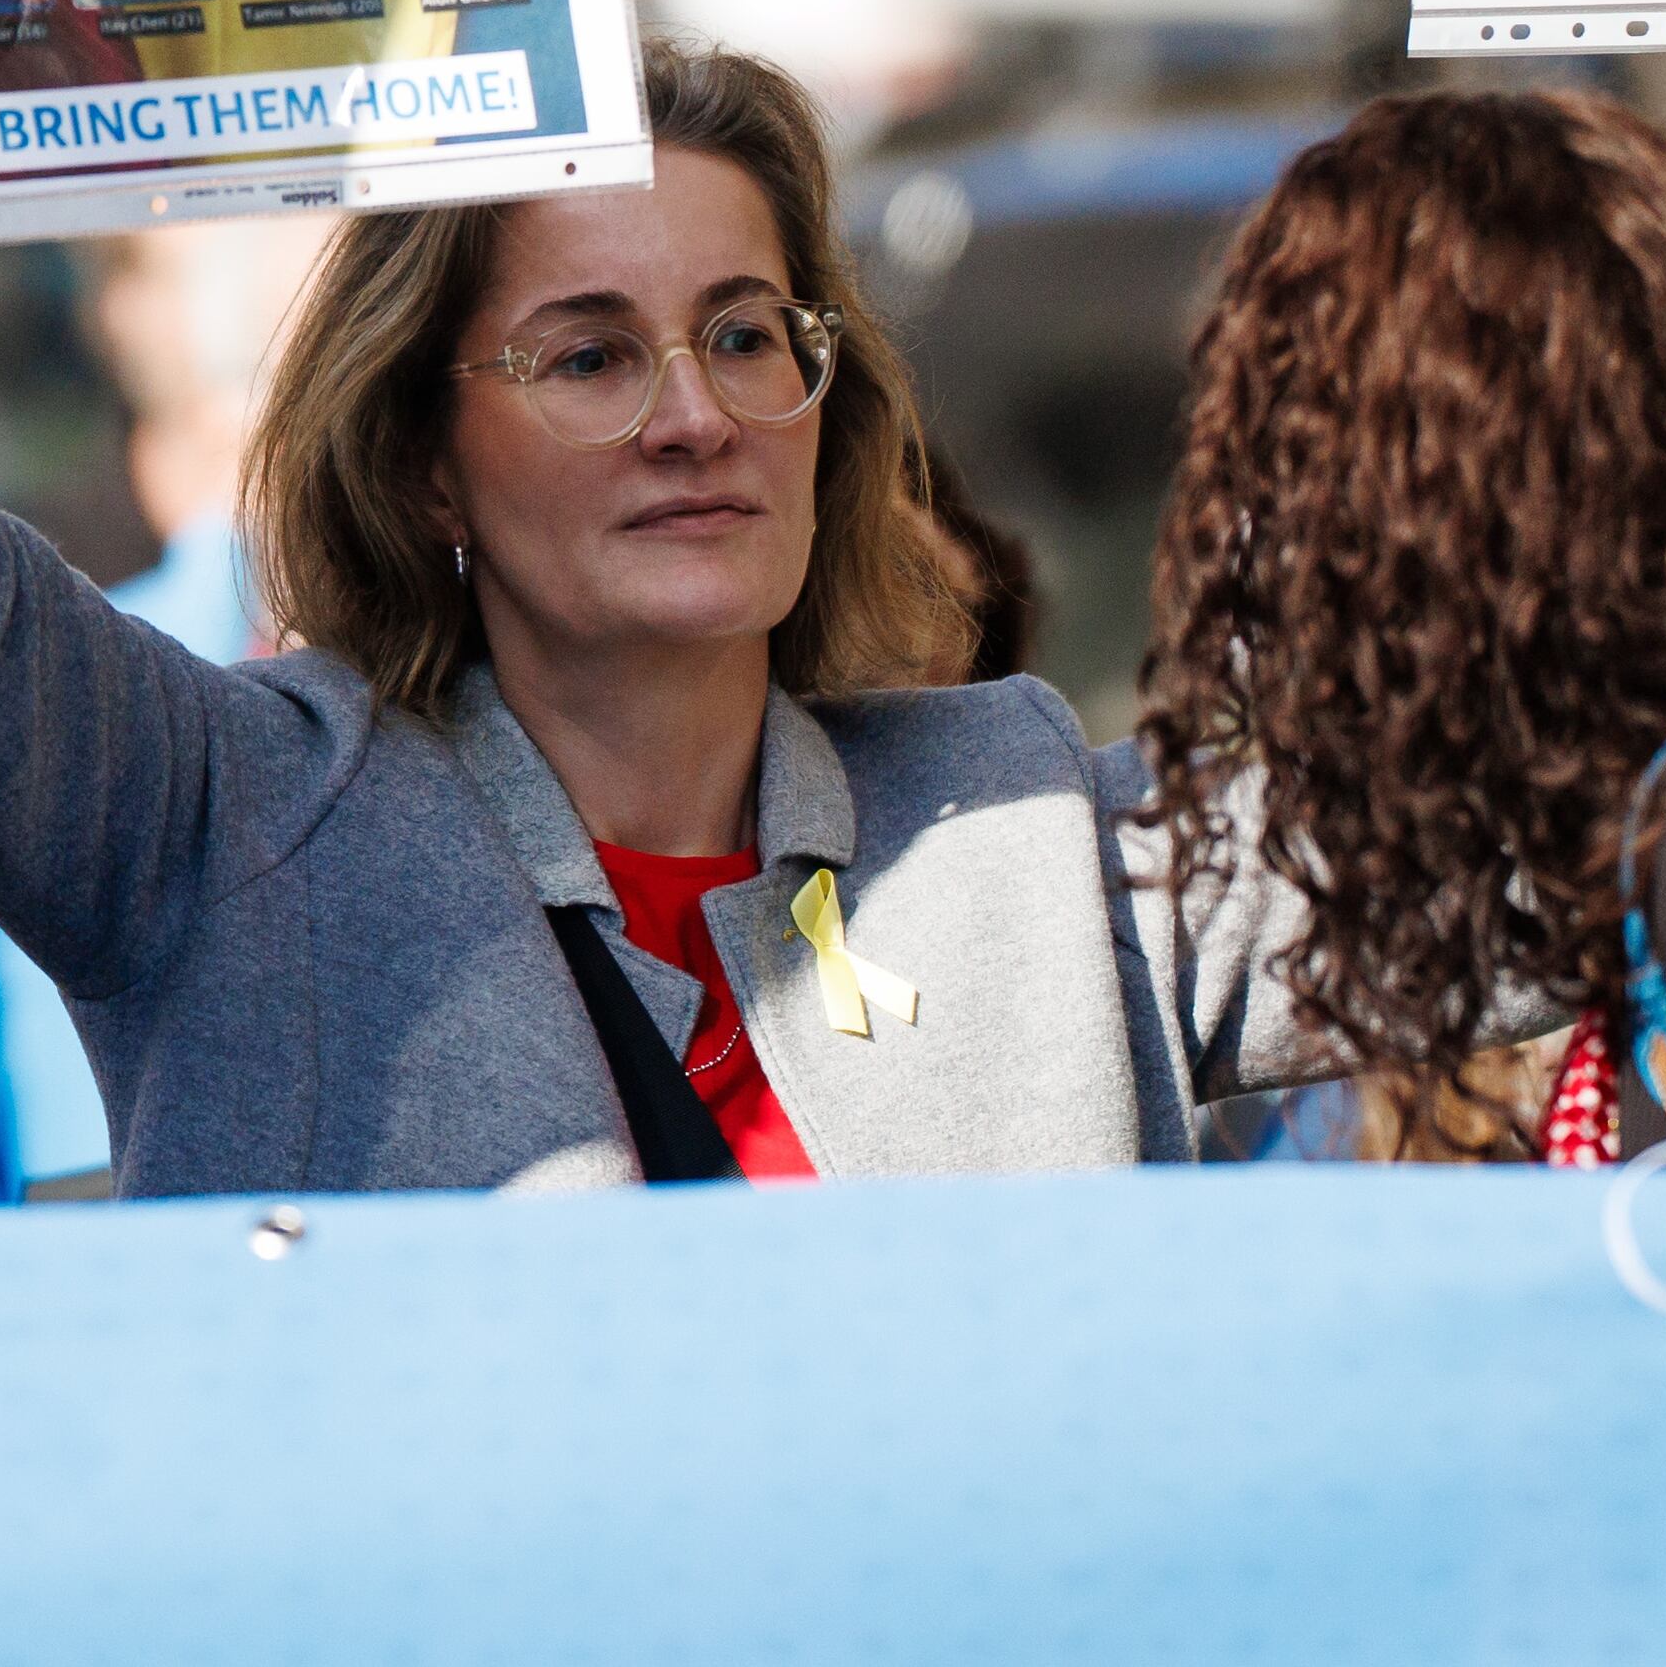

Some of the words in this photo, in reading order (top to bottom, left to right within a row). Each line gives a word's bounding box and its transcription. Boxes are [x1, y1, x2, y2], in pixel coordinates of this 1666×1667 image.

[129, 15, 168, 33] Chen
[171, 11, 204, 30] (21)
[173, 83, 332, 138] THEM
[340, 69, 519, 126] HOME!
